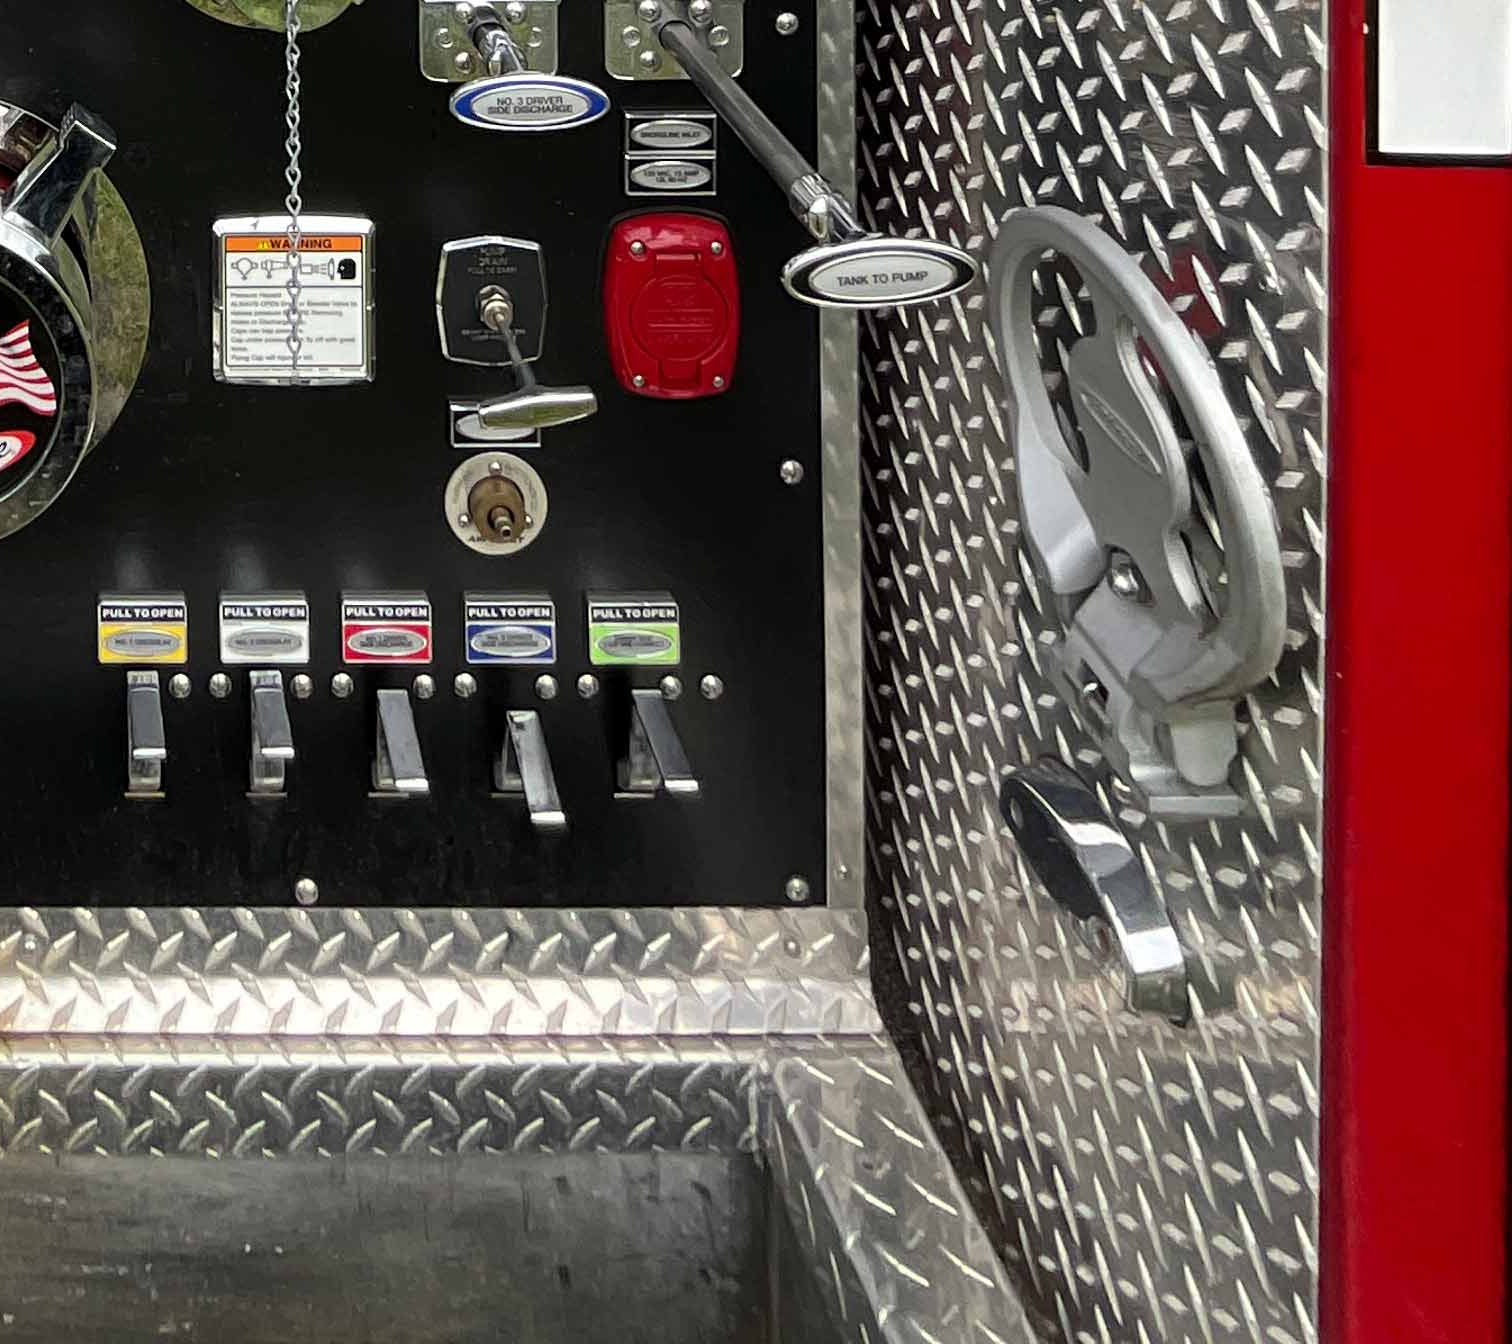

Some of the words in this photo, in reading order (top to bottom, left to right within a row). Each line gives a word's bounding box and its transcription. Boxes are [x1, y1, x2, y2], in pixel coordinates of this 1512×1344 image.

[497, 97, 516, 106] NO.
[517, 97, 523, 106] 3
[526, 97, 564, 106] DRIVER
[488, 105, 510, 114] SIDE
[513, 104, 573, 114] DISCHARGE
[271, 239, 333, 249] WANING
[837, 273, 868, 286] TANK
[872, 272, 888, 285] TO
[892, 270, 929, 283] PUMP
[103, 608, 131, 618] PULL
[134, 608, 150, 618] TO
[152, 608, 183, 618] OPEN
[224, 607, 253, 617] PULL
[256, 607, 271, 617] TO
[273, 607, 306, 617] OPEN
[346, 608, 376, 617] PULL
[378, 608, 393, 617] TO
[395, 608, 428, 617] OPEN
[469, 608, 498, 617] PULL
[500, 608, 516, 617] TO
[517, 608, 550, 617] OPEN
[593, 609, 623, 618] PULL
[624, 609, 642, 618] TO
[642, 609, 675, 618] OPEN
